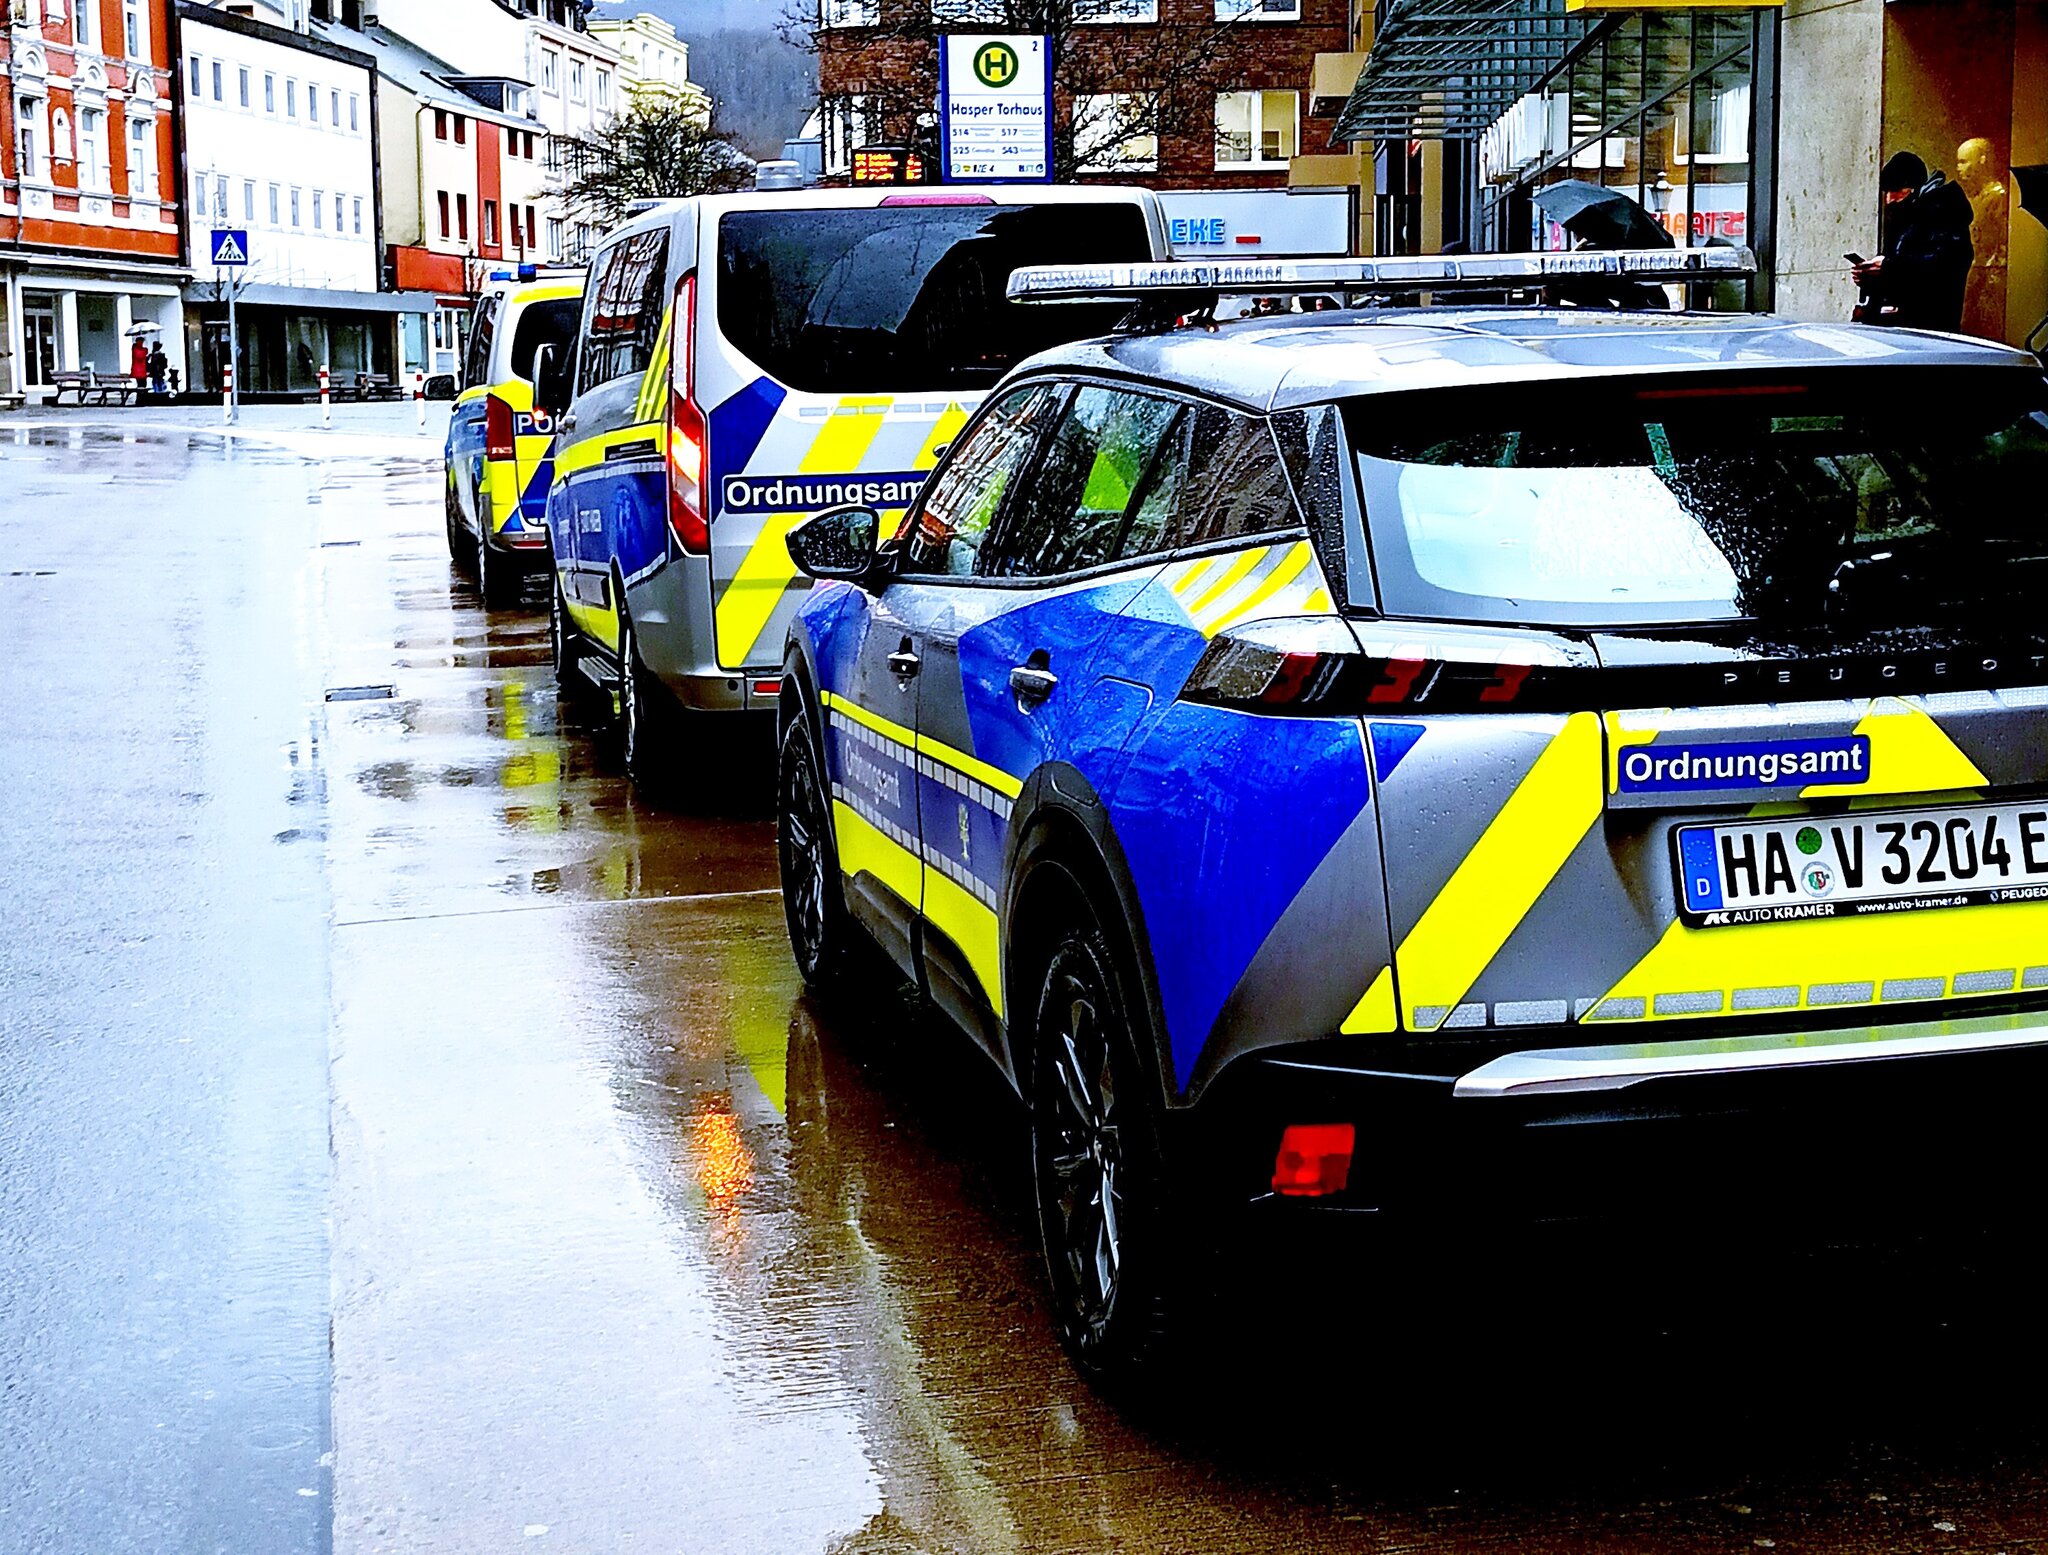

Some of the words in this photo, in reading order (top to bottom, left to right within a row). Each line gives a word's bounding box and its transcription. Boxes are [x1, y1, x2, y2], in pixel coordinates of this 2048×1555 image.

[1032, 40, 1038, 52] 2
[985, 52, 1007, 76] H
[951, 102, 993, 118] Hasper
[997, 102, 1043, 115] Torhaus
[726, 480, 926, 507] Ordnungsam
[1723, 655, 2045, 685] PEUGEOT
[1625, 743, 1863, 783] Ordnungsamt
[1696, 877, 1711, 897] D
[1721, 831, 1797, 898] HA
[1830, 825, 1864, 889] V
[1733, 909, 1772, 923] AUTO
[1774, 903, 1835, 920] KRAMER
[1855, 895, 1969, 913] www.auto-kramer.de
